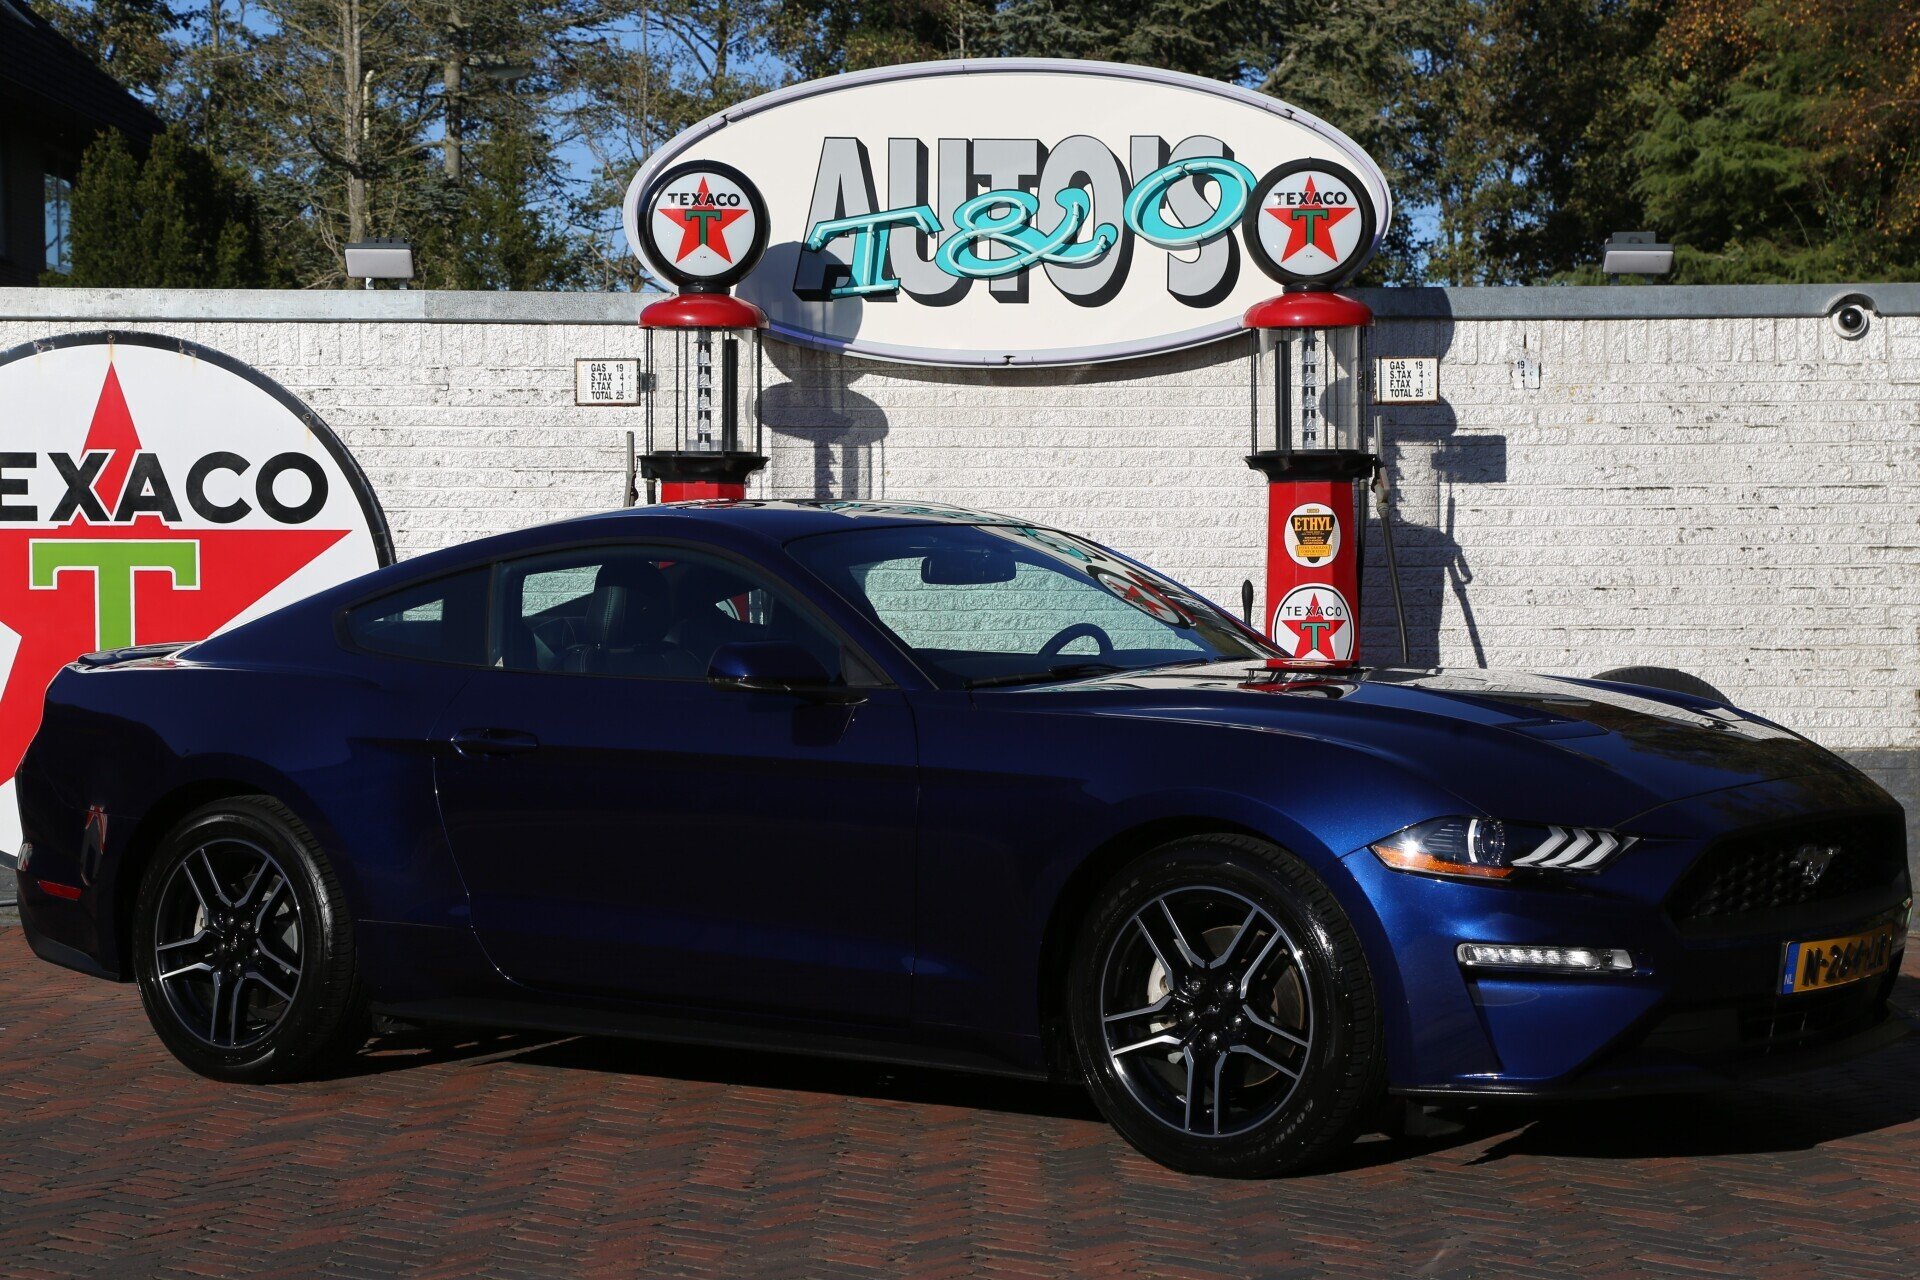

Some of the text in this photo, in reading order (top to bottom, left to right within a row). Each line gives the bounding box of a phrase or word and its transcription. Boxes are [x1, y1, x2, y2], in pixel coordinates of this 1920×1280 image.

[667, 193, 741, 207] TEXACO
[1274, 192, 1348, 206] TEXACO
[804, 203, 945, 300] T
[935, 188, 1119, 279] &
[591, 363, 624, 372] GAS 19
[1389, 361, 1423, 370] GAS 19
[1517, 360, 1525, 369] 19
[591, 373, 624, 381] S.TAX 4
[1389, 370, 1423, 379] S.TAX 4
[591, 382, 611, 390] F.TAX
[1389, 379, 1411, 388] F.TAX
[591, 391, 624, 400] TOTAL 25
[1389, 388, 1424, 397] TOTAL 25
[1293, 516, 1333, 532] ETHYL
[1285, 606, 1342, 617] TEXACO
[1783, 973, 1793, 985] NL
